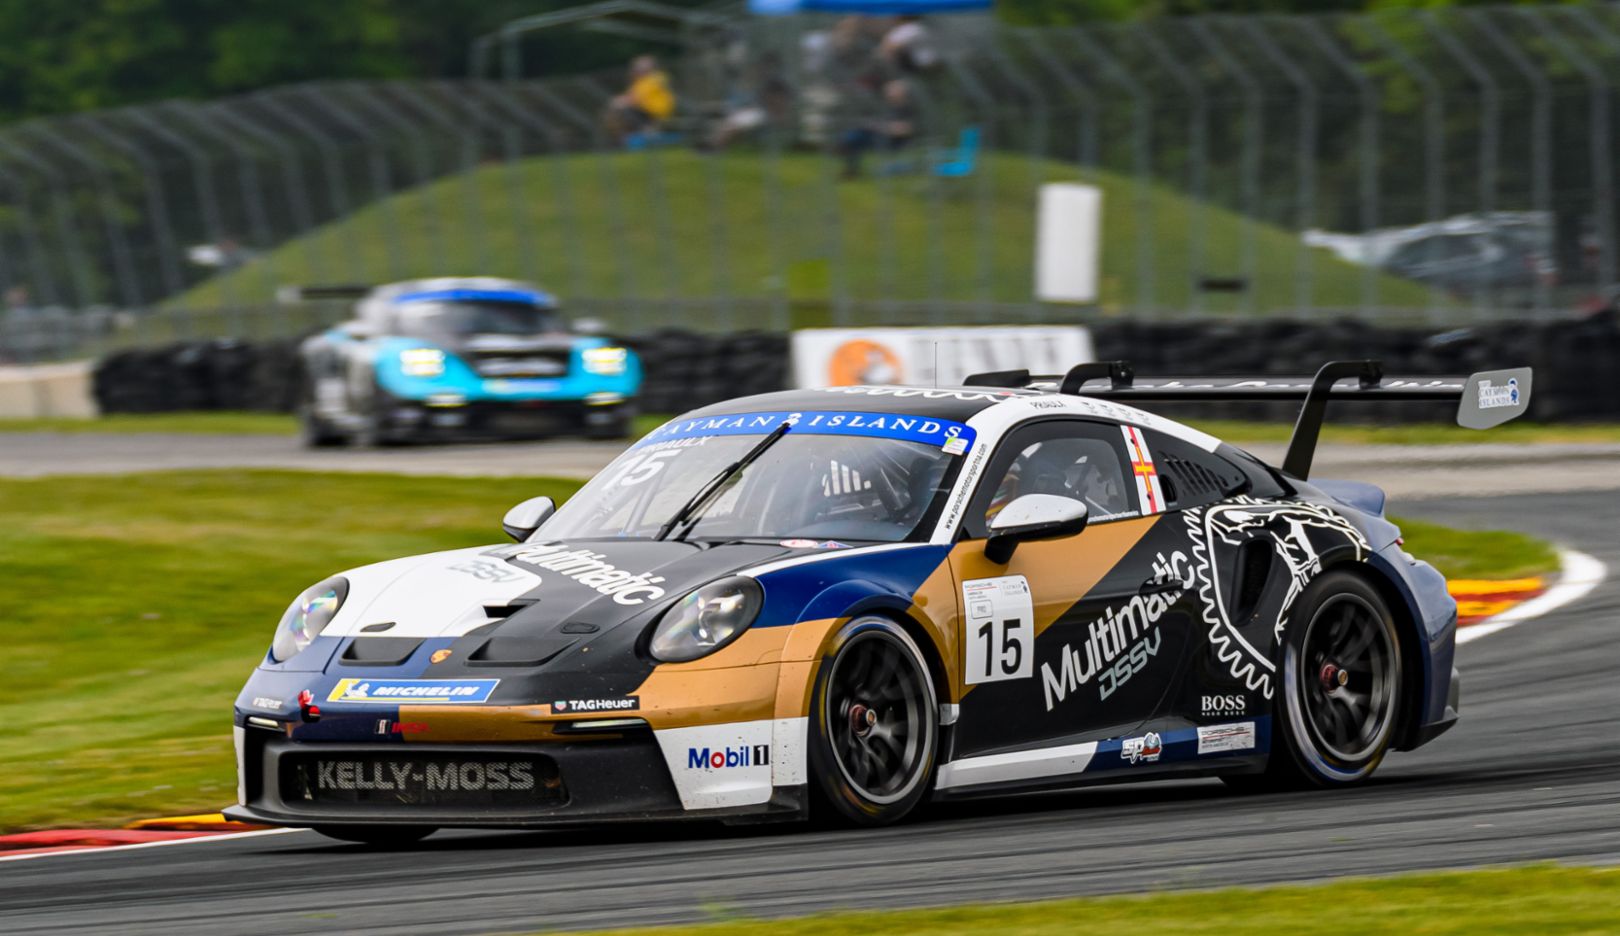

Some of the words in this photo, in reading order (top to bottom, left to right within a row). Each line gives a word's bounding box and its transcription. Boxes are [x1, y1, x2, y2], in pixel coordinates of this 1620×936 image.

[807, 413, 962, 439] ISLANDS
[601, 449, 682, 491] 15
[1041, 550, 1195, 712] Multimatic
[978, 618, 1022, 677] 15
[1098, 626, 1161, 701] DSSV
[373, 685, 480, 696] MICHELIN
[1201, 694, 1246, 711] BOSS
[687, 746, 749, 769] Mobil
[317, 761, 535, 792] KELLY-MOSS
